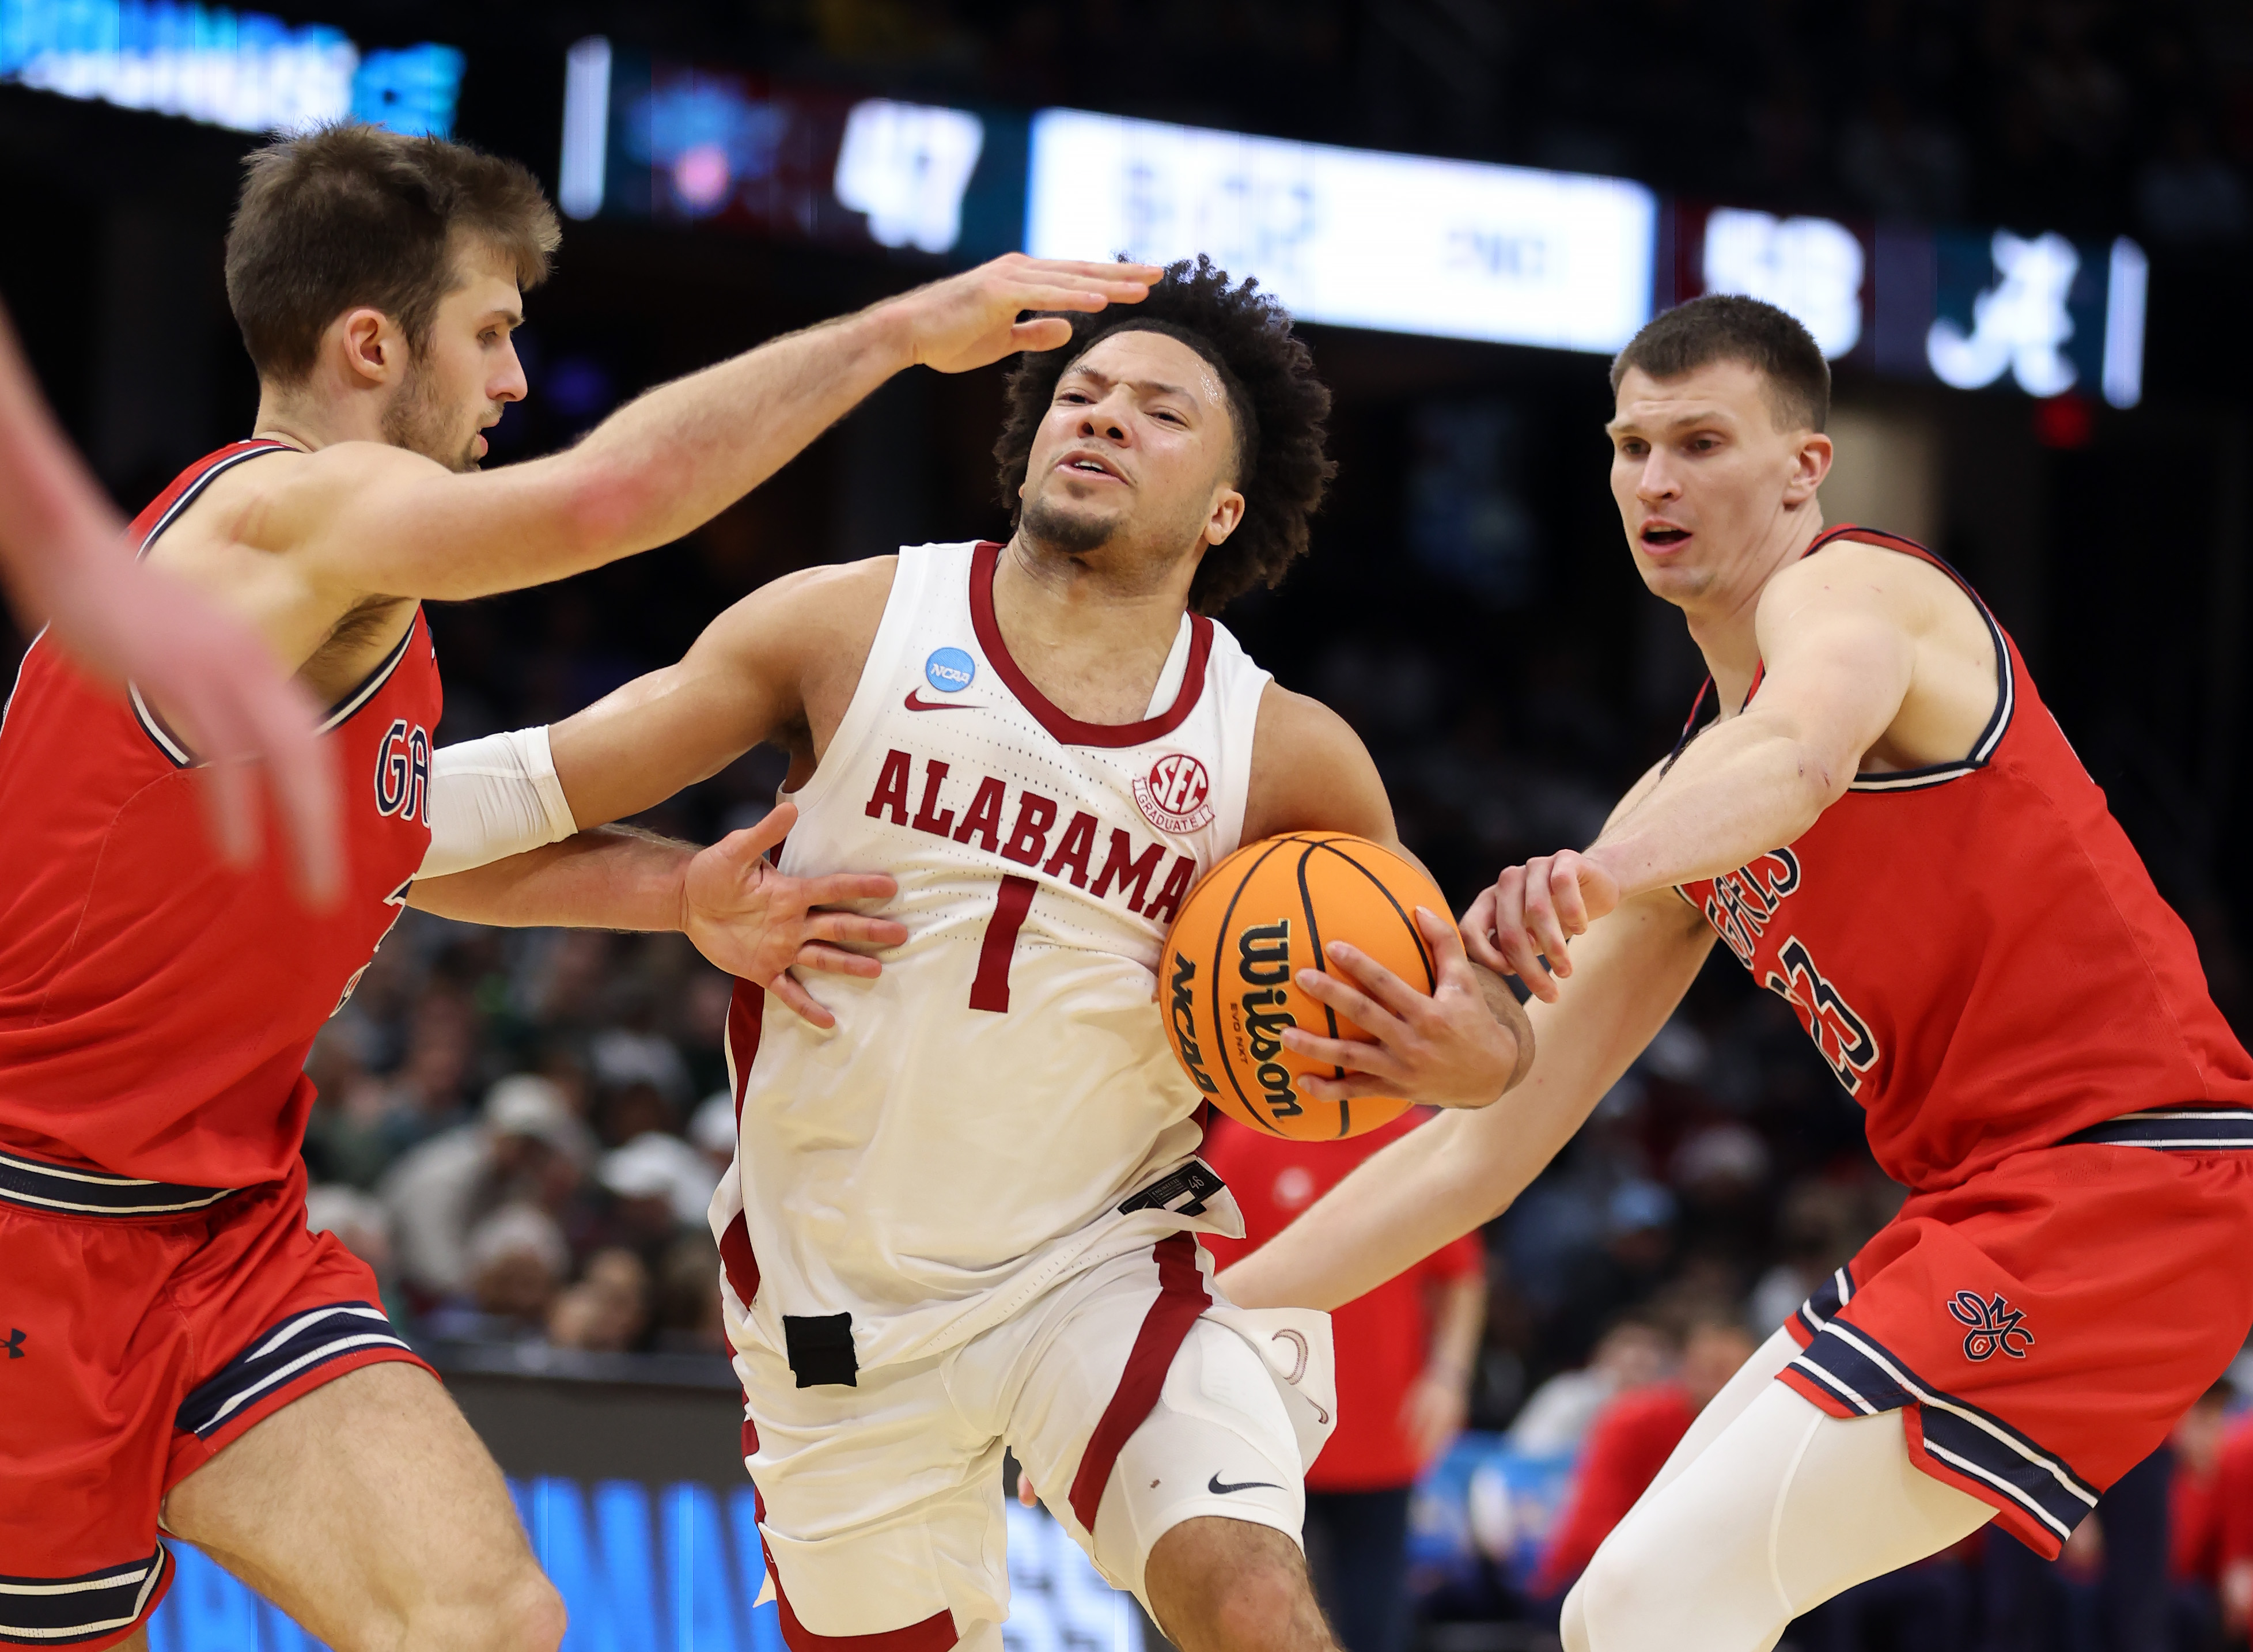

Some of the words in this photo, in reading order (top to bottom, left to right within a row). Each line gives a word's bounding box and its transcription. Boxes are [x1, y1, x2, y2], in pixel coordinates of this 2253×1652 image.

[930, 662, 971, 684] NCAA
[374, 719, 431, 828] GA
[1152, 756, 1207, 813] SEC
[865, 748, 1196, 924] ALABAMA
[1138, 794, 1199, 831] GRADUATE
[968, 874, 1039, 1014] 1
[1172, 950, 1221, 1094] NCAA
[1230, 1002, 1241, 1032] EVO
[1238, 917, 1304, 1119] Wilson
[1235, 1037, 1249, 1065] NXT
[1188, 1175, 1205, 1189] 46
